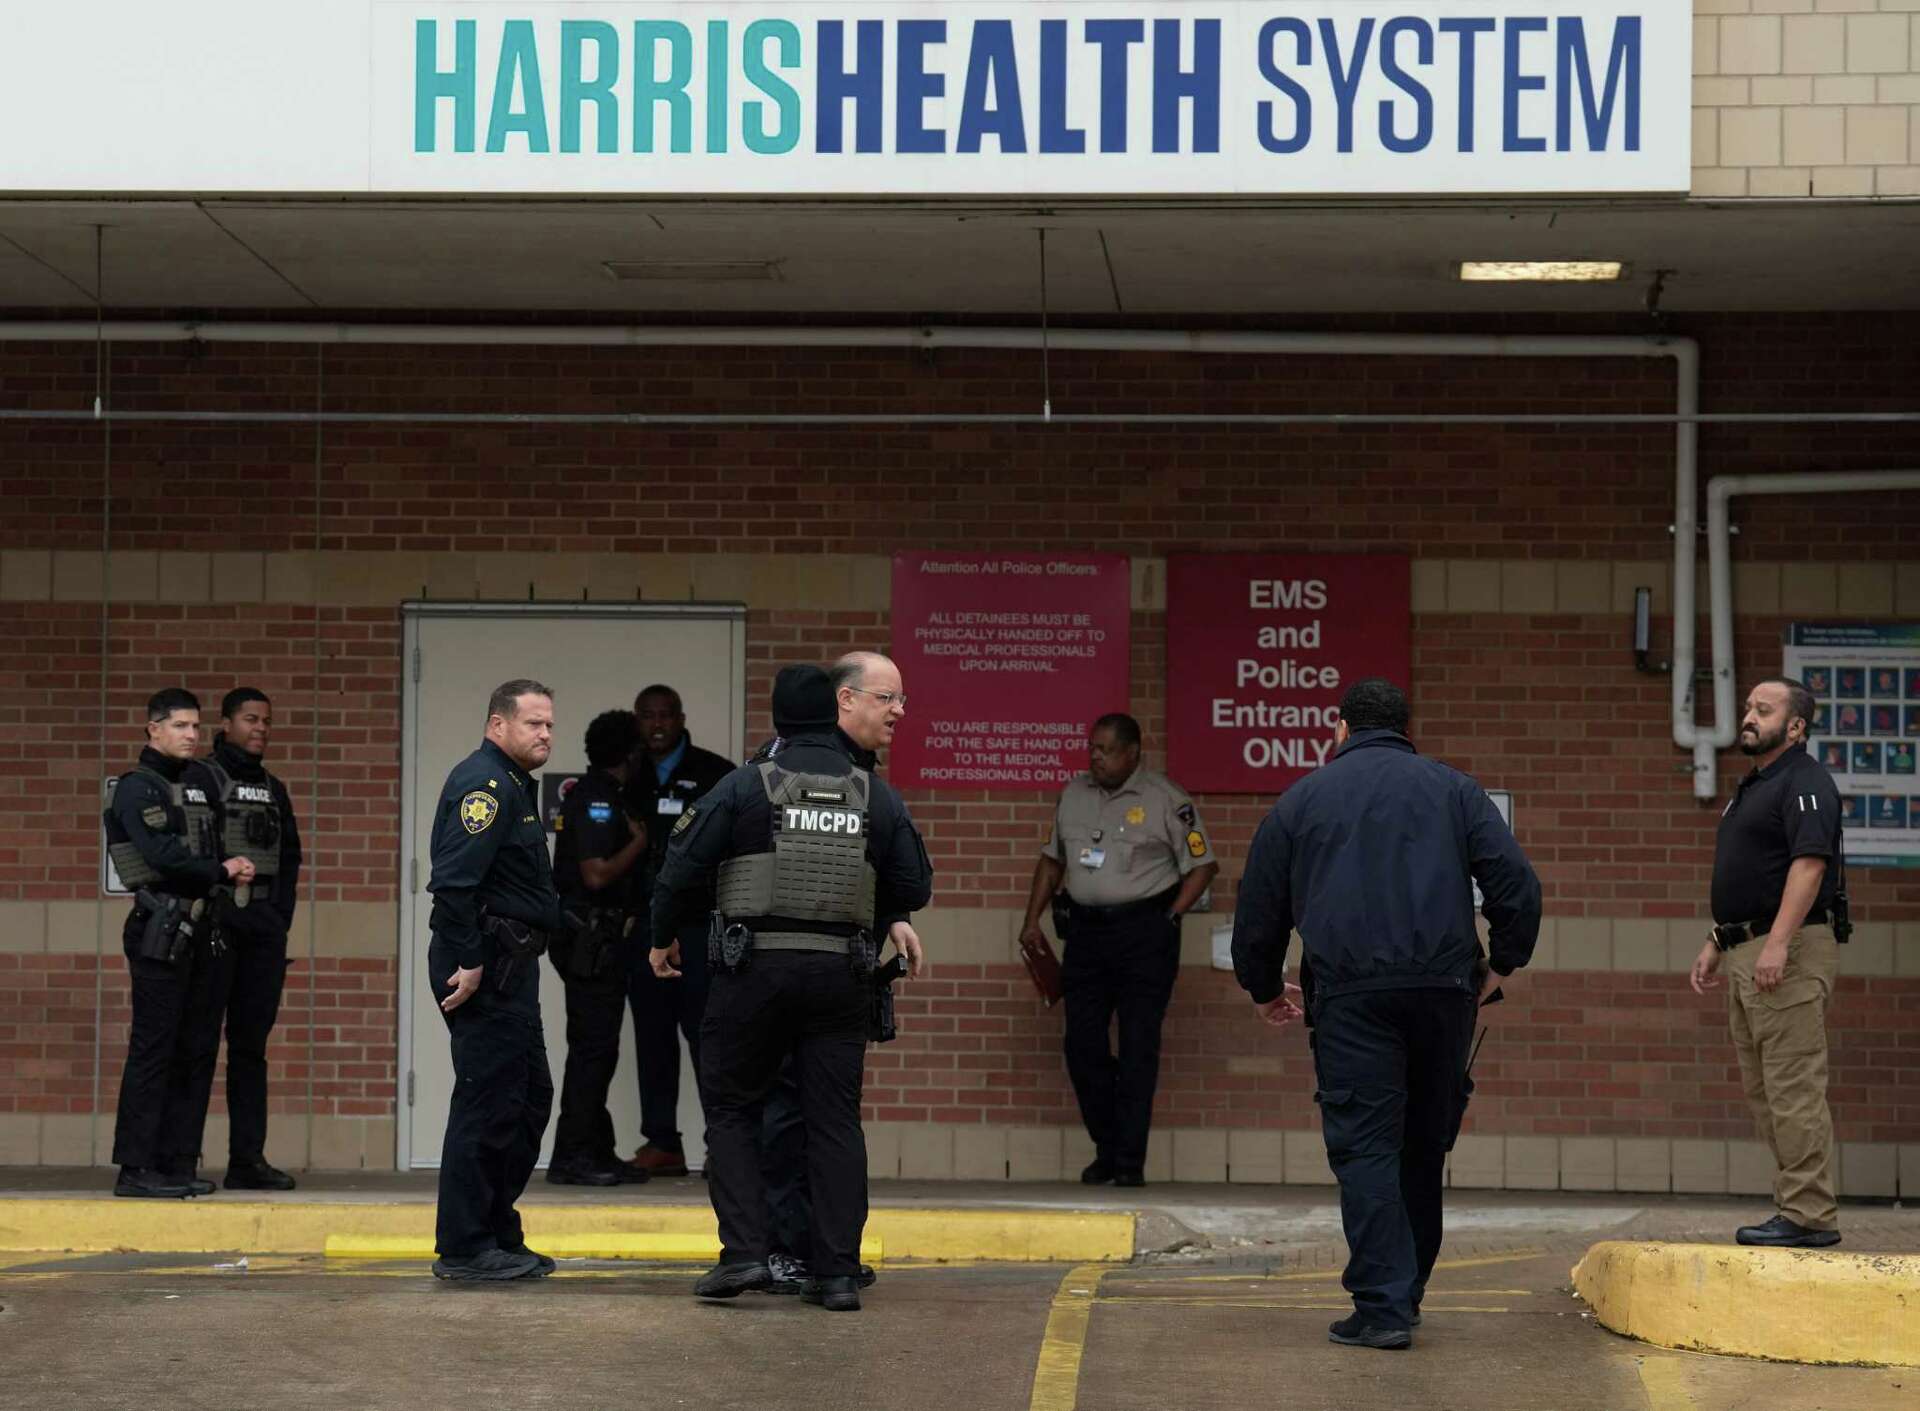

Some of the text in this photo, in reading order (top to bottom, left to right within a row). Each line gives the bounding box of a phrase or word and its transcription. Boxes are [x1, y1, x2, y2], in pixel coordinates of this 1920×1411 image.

[1257, 16, 1642, 153] SYSTEM
[920, 560, 1098, 576] Attention All Police Officers
[1250, 579, 1328, 610] EMS
[929, 612, 1091, 627] ALL DETAINEES MUST BE
[915, 628, 1105, 643] PHYSICALLY HANDED OFF TO
[1257, 620, 1321, 648] and
[923, 643, 1096, 658] MEDICAL PROFESSIONALS
[959, 659, 998, 672] UPON
[1237, 659, 1340, 688] Police
[1212, 699, 1340, 728] Entranc
[931, 721, 1086, 736] YOU ARE RESPONSIBLE
[925, 736, 953, 749] FOR
[958, 736, 982, 750] THE
[986, 736, 1020, 750] SAFE
[1024, 738, 1061, 751] HAND
[954, 752, 1063, 768] TO THE MEDICAL
[1243, 737, 1333, 767] ONLY
[920, 767, 1031, 782] PROFESSIONALS
[1035, 768, 1055, 782] ON
[238, 786, 271, 802] POLICE
[786, 808, 860, 834] TMCPD
